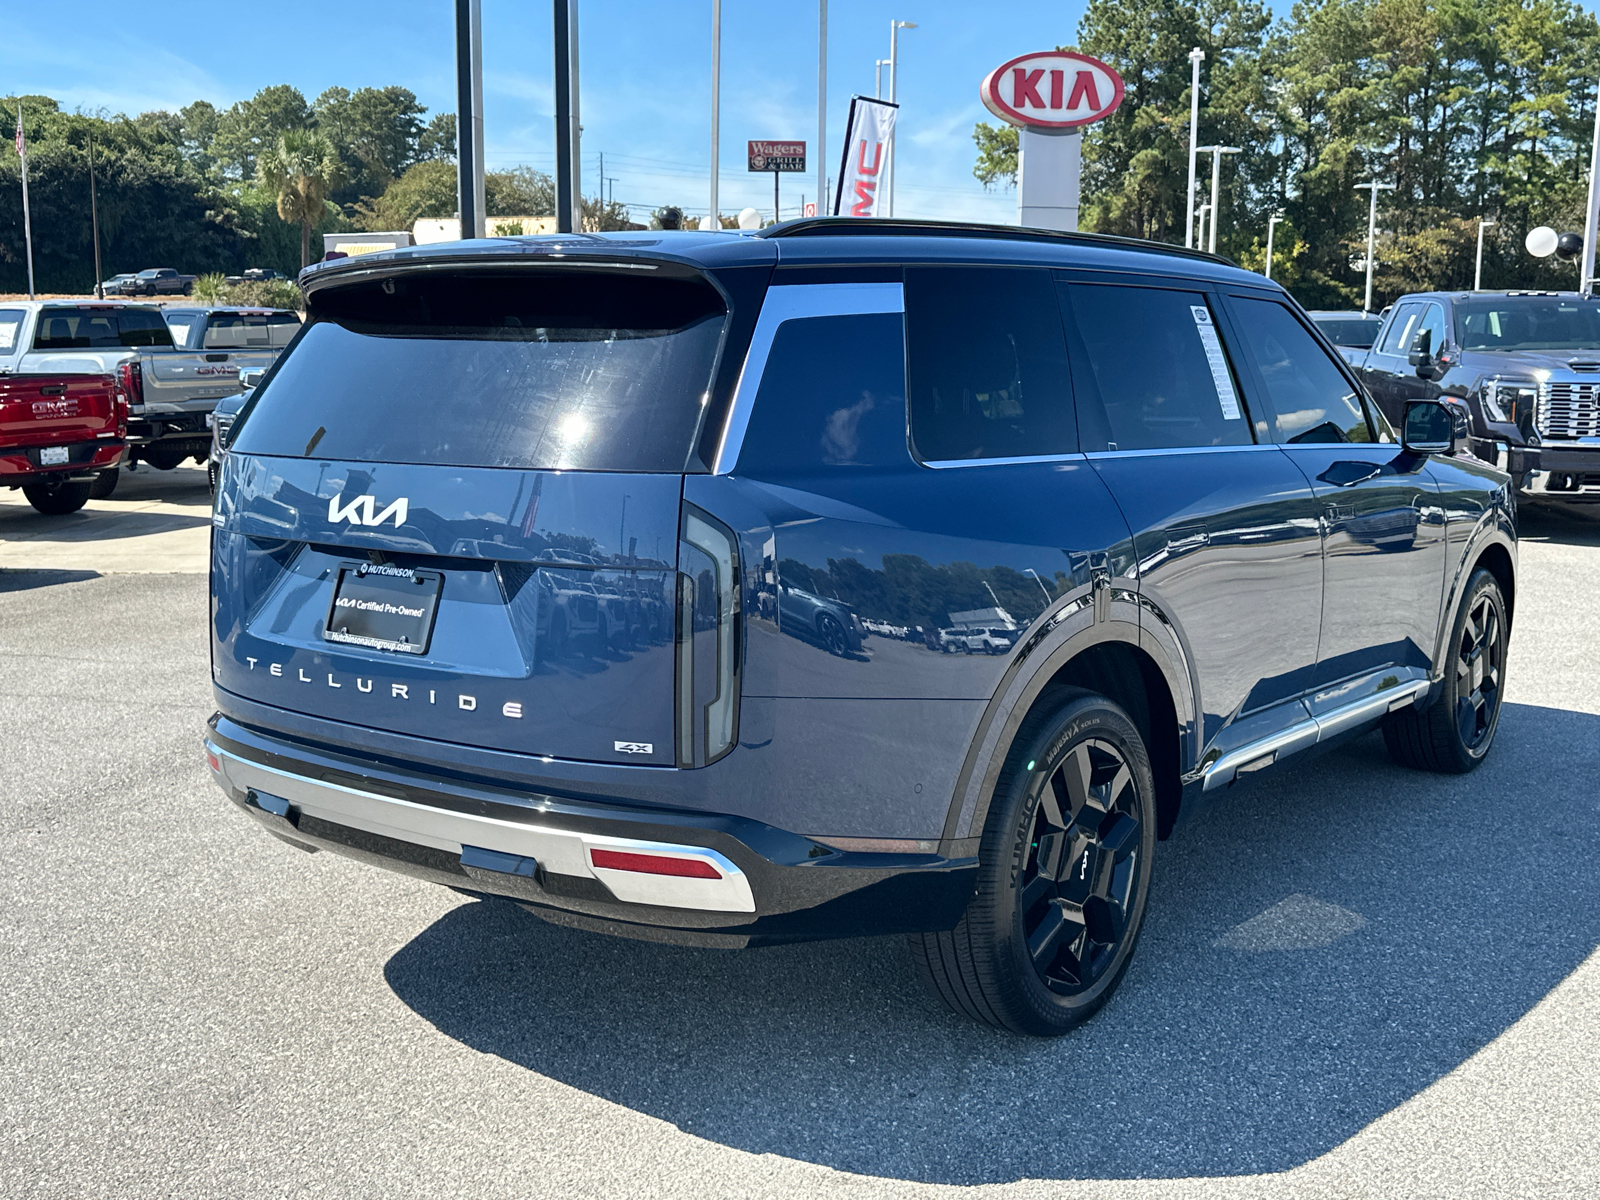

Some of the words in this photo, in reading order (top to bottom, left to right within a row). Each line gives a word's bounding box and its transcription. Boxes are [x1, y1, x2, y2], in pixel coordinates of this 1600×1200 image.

[1012, 68, 1102, 111] KIA
[751, 142, 803, 157] Wagers
[850, 140, 882, 217] MC
[328, 492, 408, 529] KIA
[367, 565, 414, 578] HUTCHINSON
[356, 600, 384, 612] Certified
[331, 633, 411, 652] Hutchinsonautogroup.com
[246, 656, 523, 720] TELLURIDE
[1009, 792, 1035, 889] KUMHO
